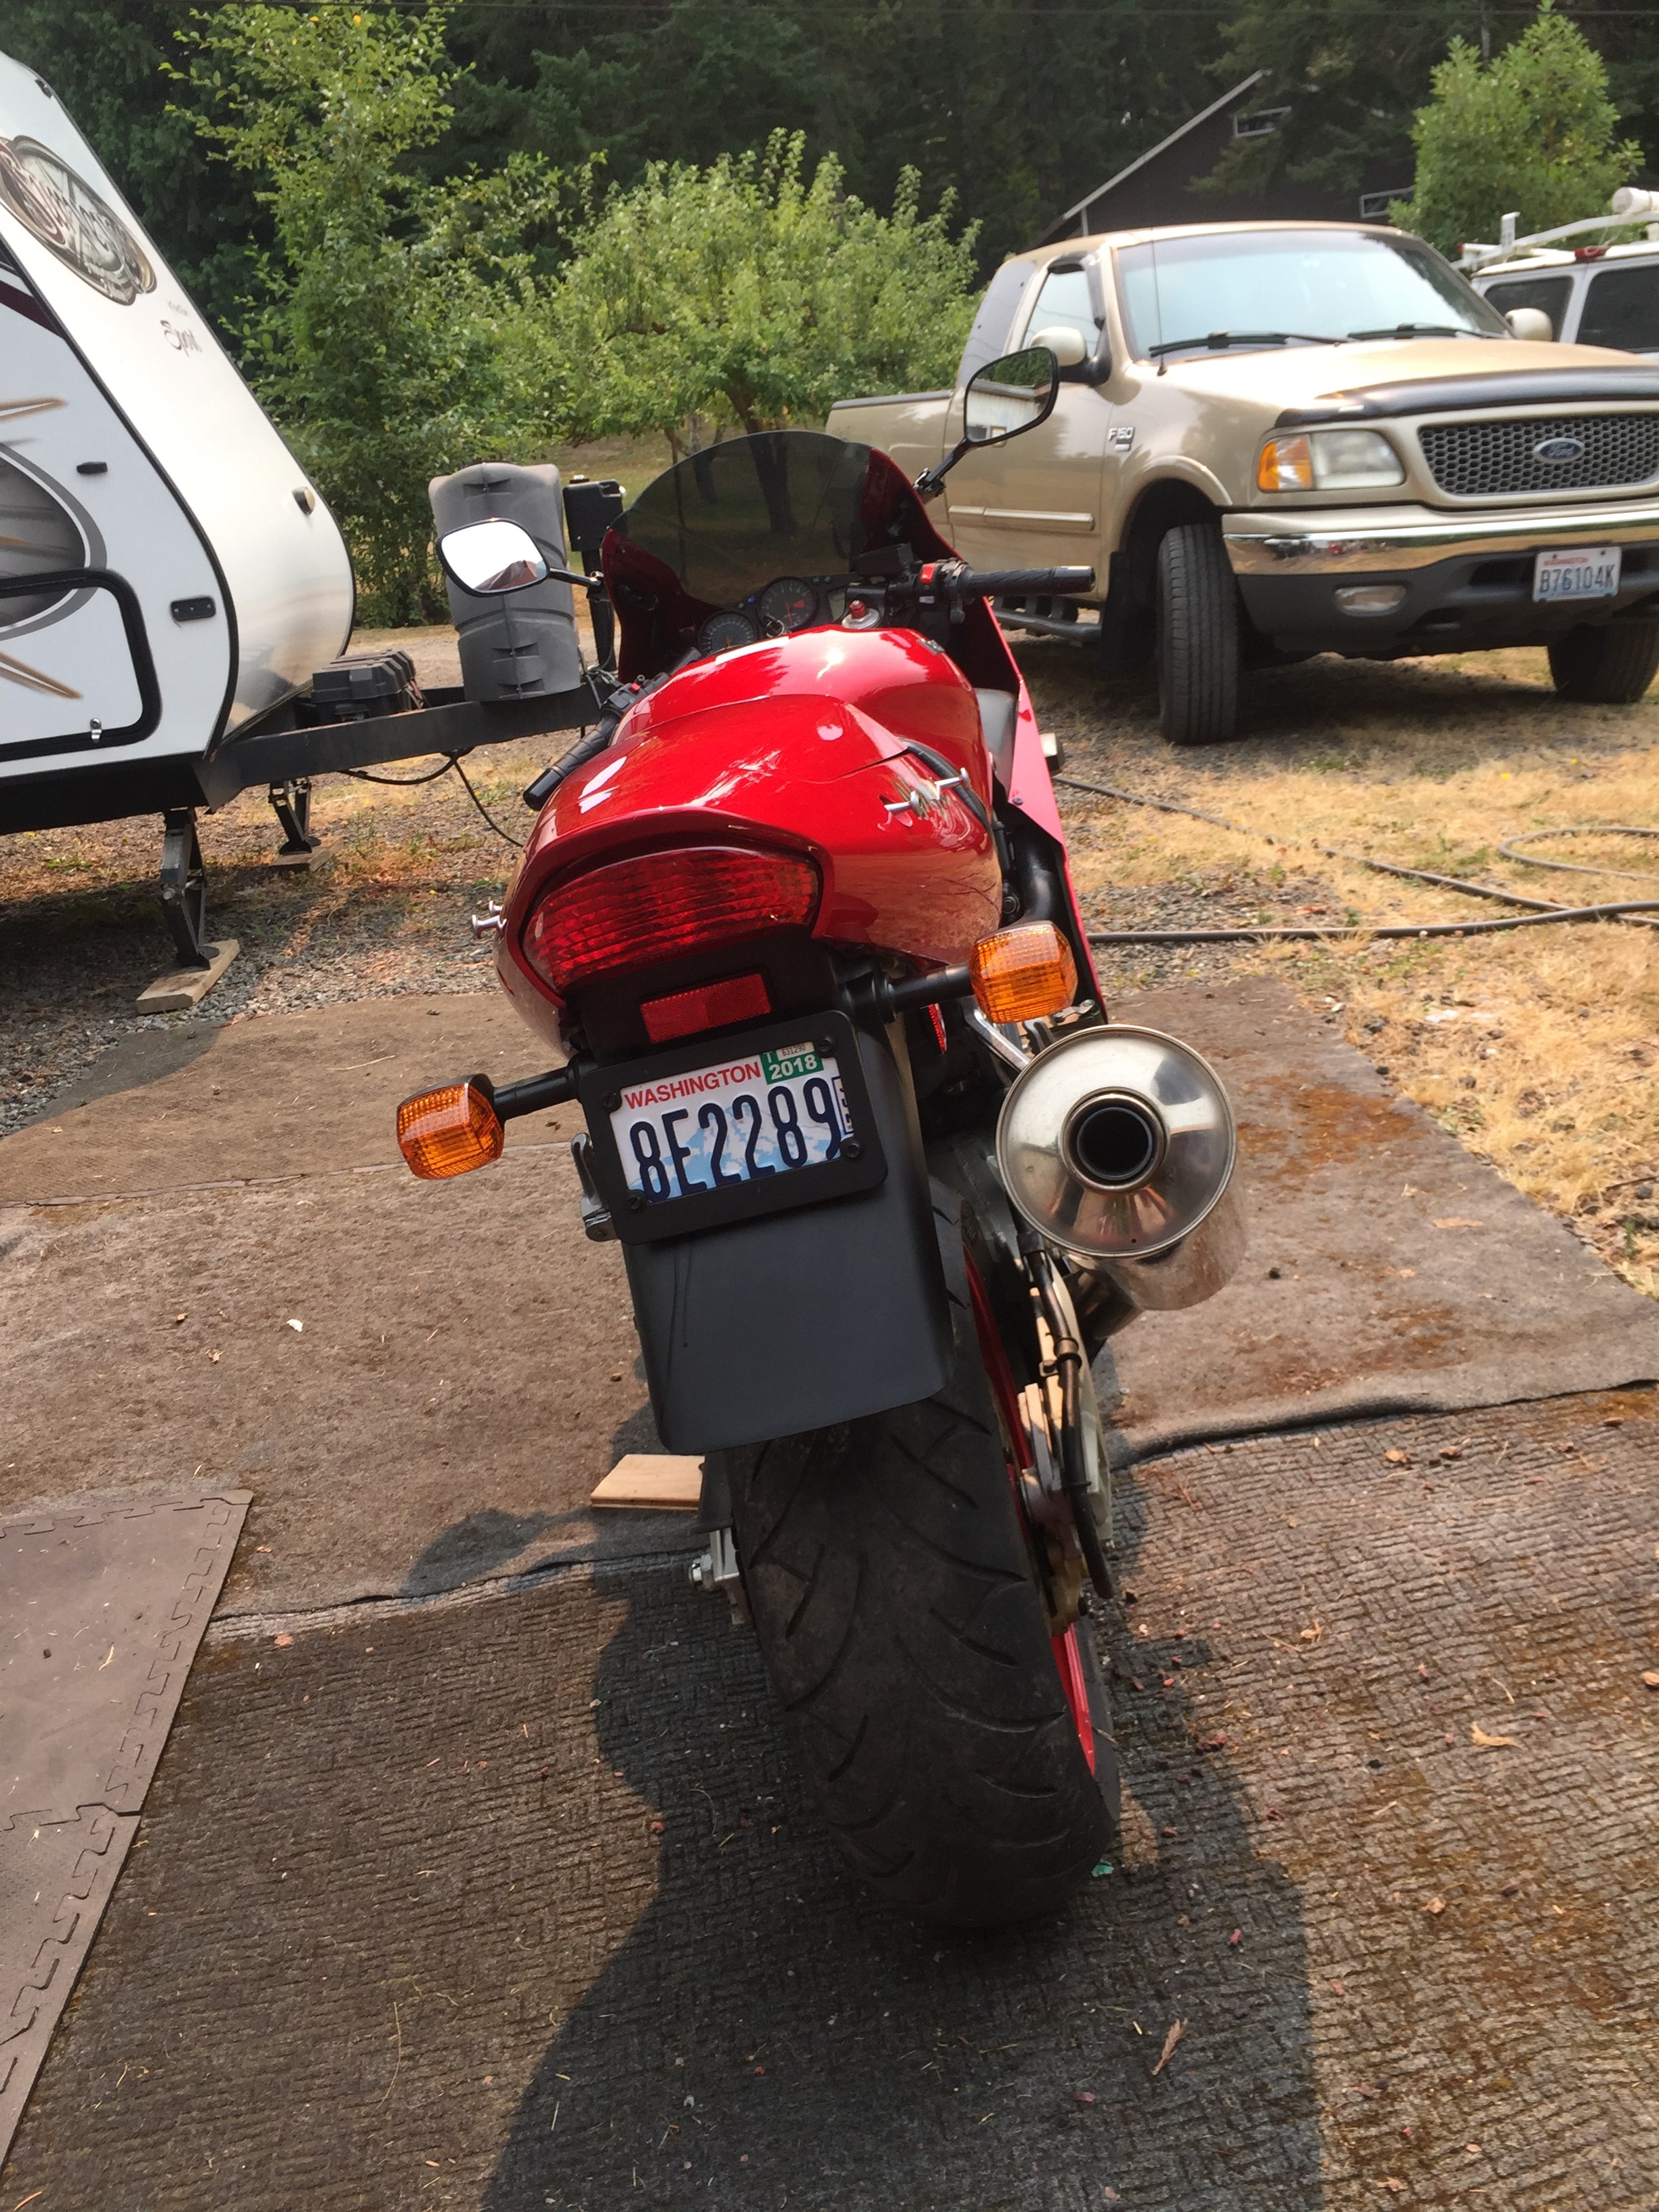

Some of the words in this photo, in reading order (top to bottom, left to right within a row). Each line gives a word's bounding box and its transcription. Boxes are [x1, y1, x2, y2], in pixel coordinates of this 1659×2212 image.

[1539, 564, 1615, 594] B76104K
[625, 1061, 762, 1109] WASHINGTON
[769, 1054, 818, 1080] 2018
[630, 1077, 842, 1203] 8E2289
